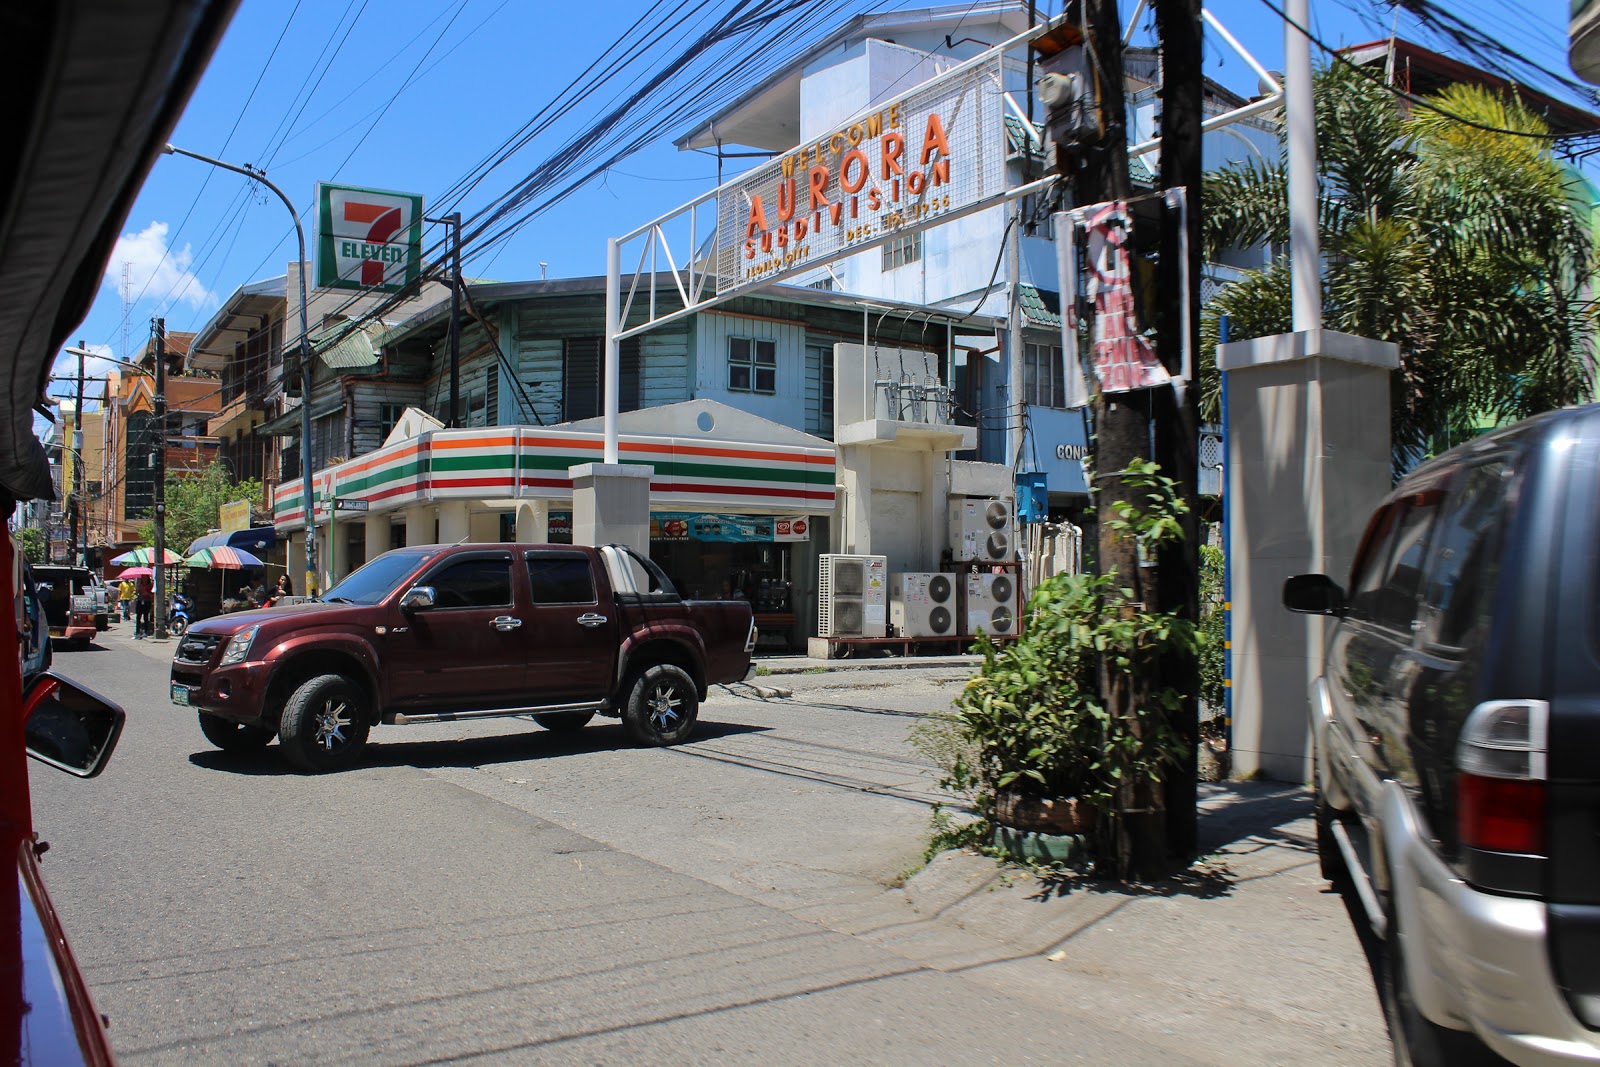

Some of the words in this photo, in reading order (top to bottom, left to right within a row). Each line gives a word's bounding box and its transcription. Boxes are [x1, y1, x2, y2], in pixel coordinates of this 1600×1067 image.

[746, 113, 950, 238] AURORA
[781, 103, 901, 178] WELCOME
[343, 201, 402, 287] 7
[745, 158, 950, 260] SUBDIVISION
[914, 195, 950, 217] 1956
